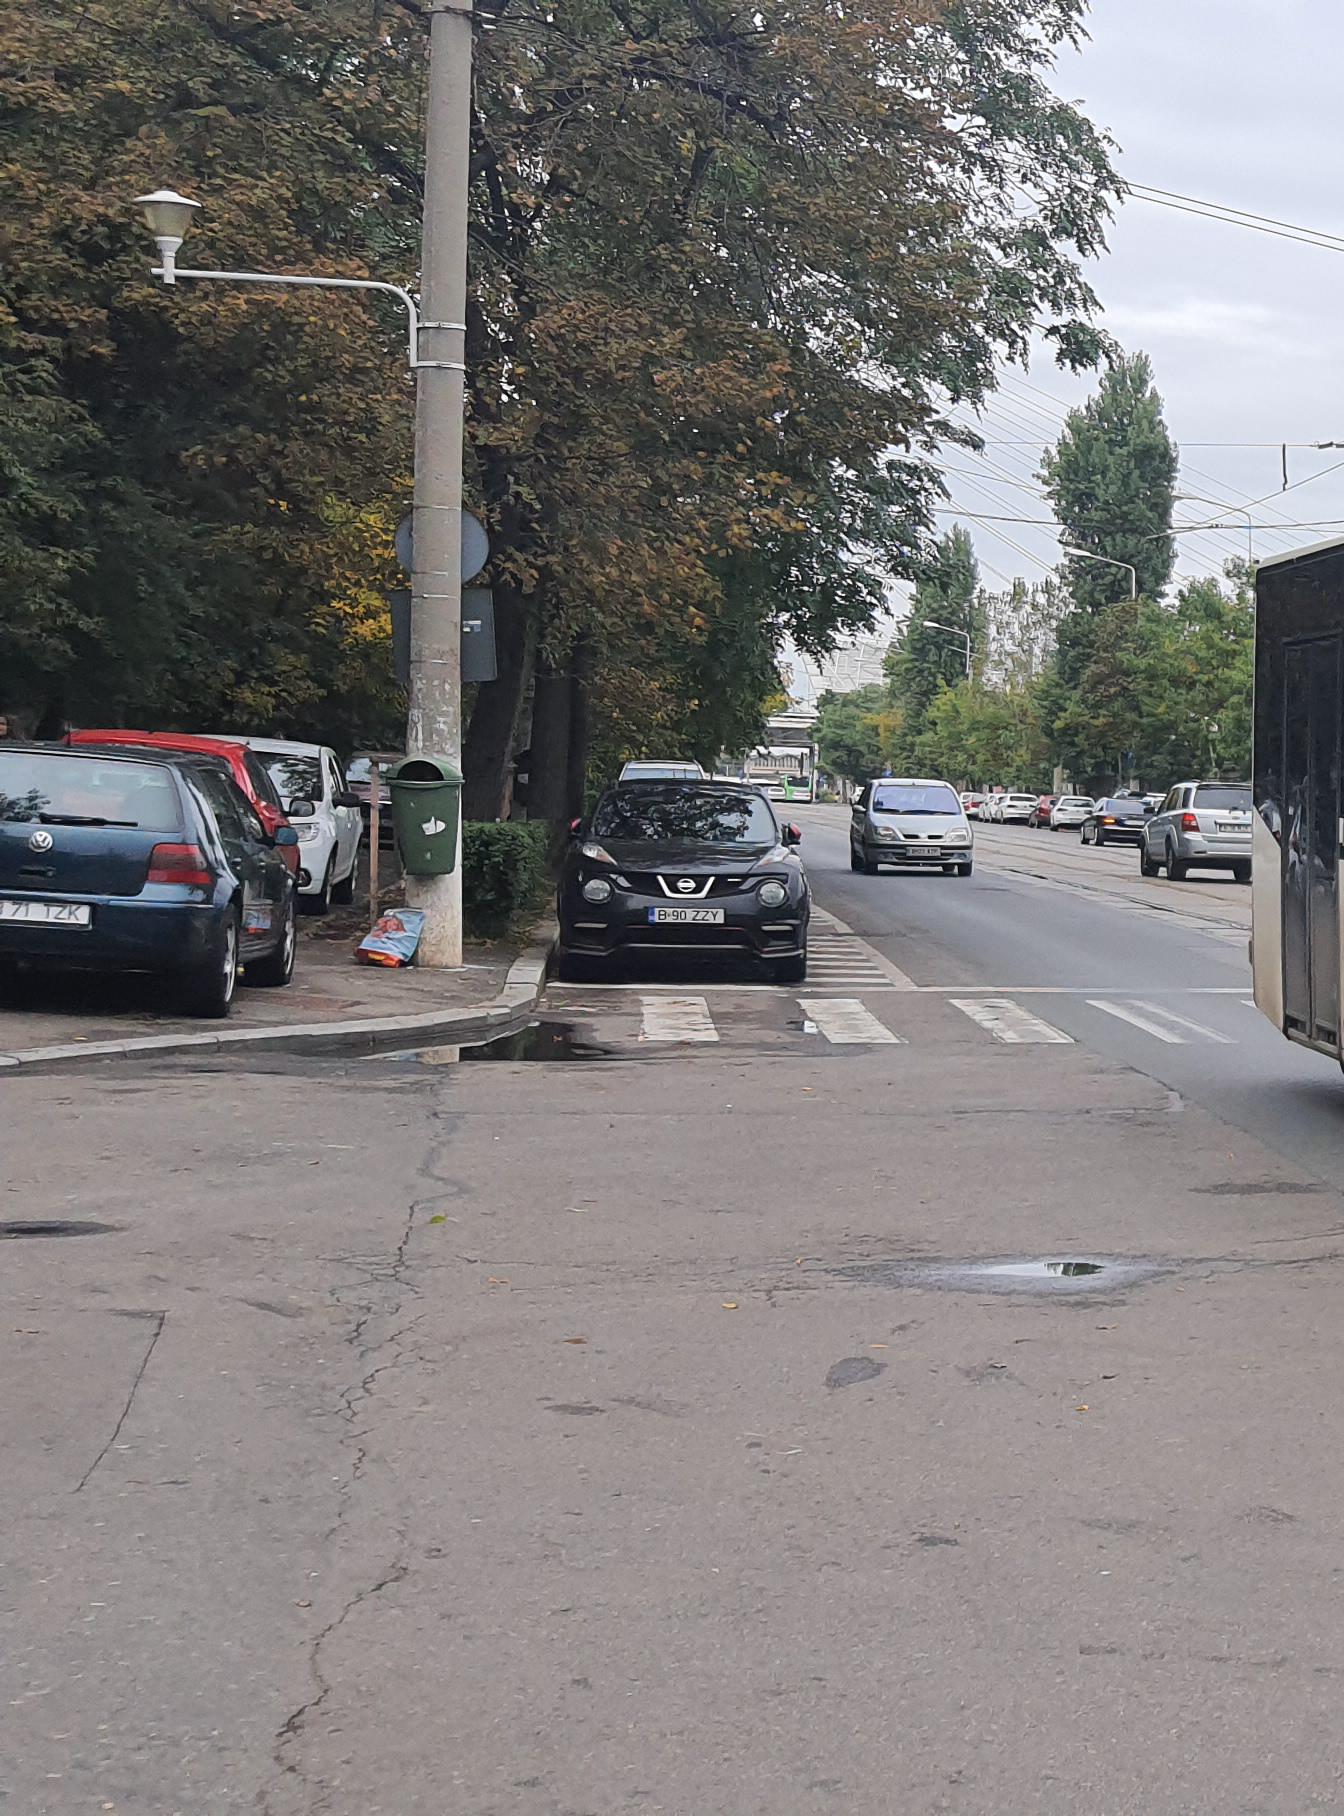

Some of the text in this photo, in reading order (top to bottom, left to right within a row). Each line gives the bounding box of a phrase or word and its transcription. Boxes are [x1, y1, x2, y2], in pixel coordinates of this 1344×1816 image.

[43, 903, 81, 921] TZK
[658, 909, 719, 922] B 90 ZZY
